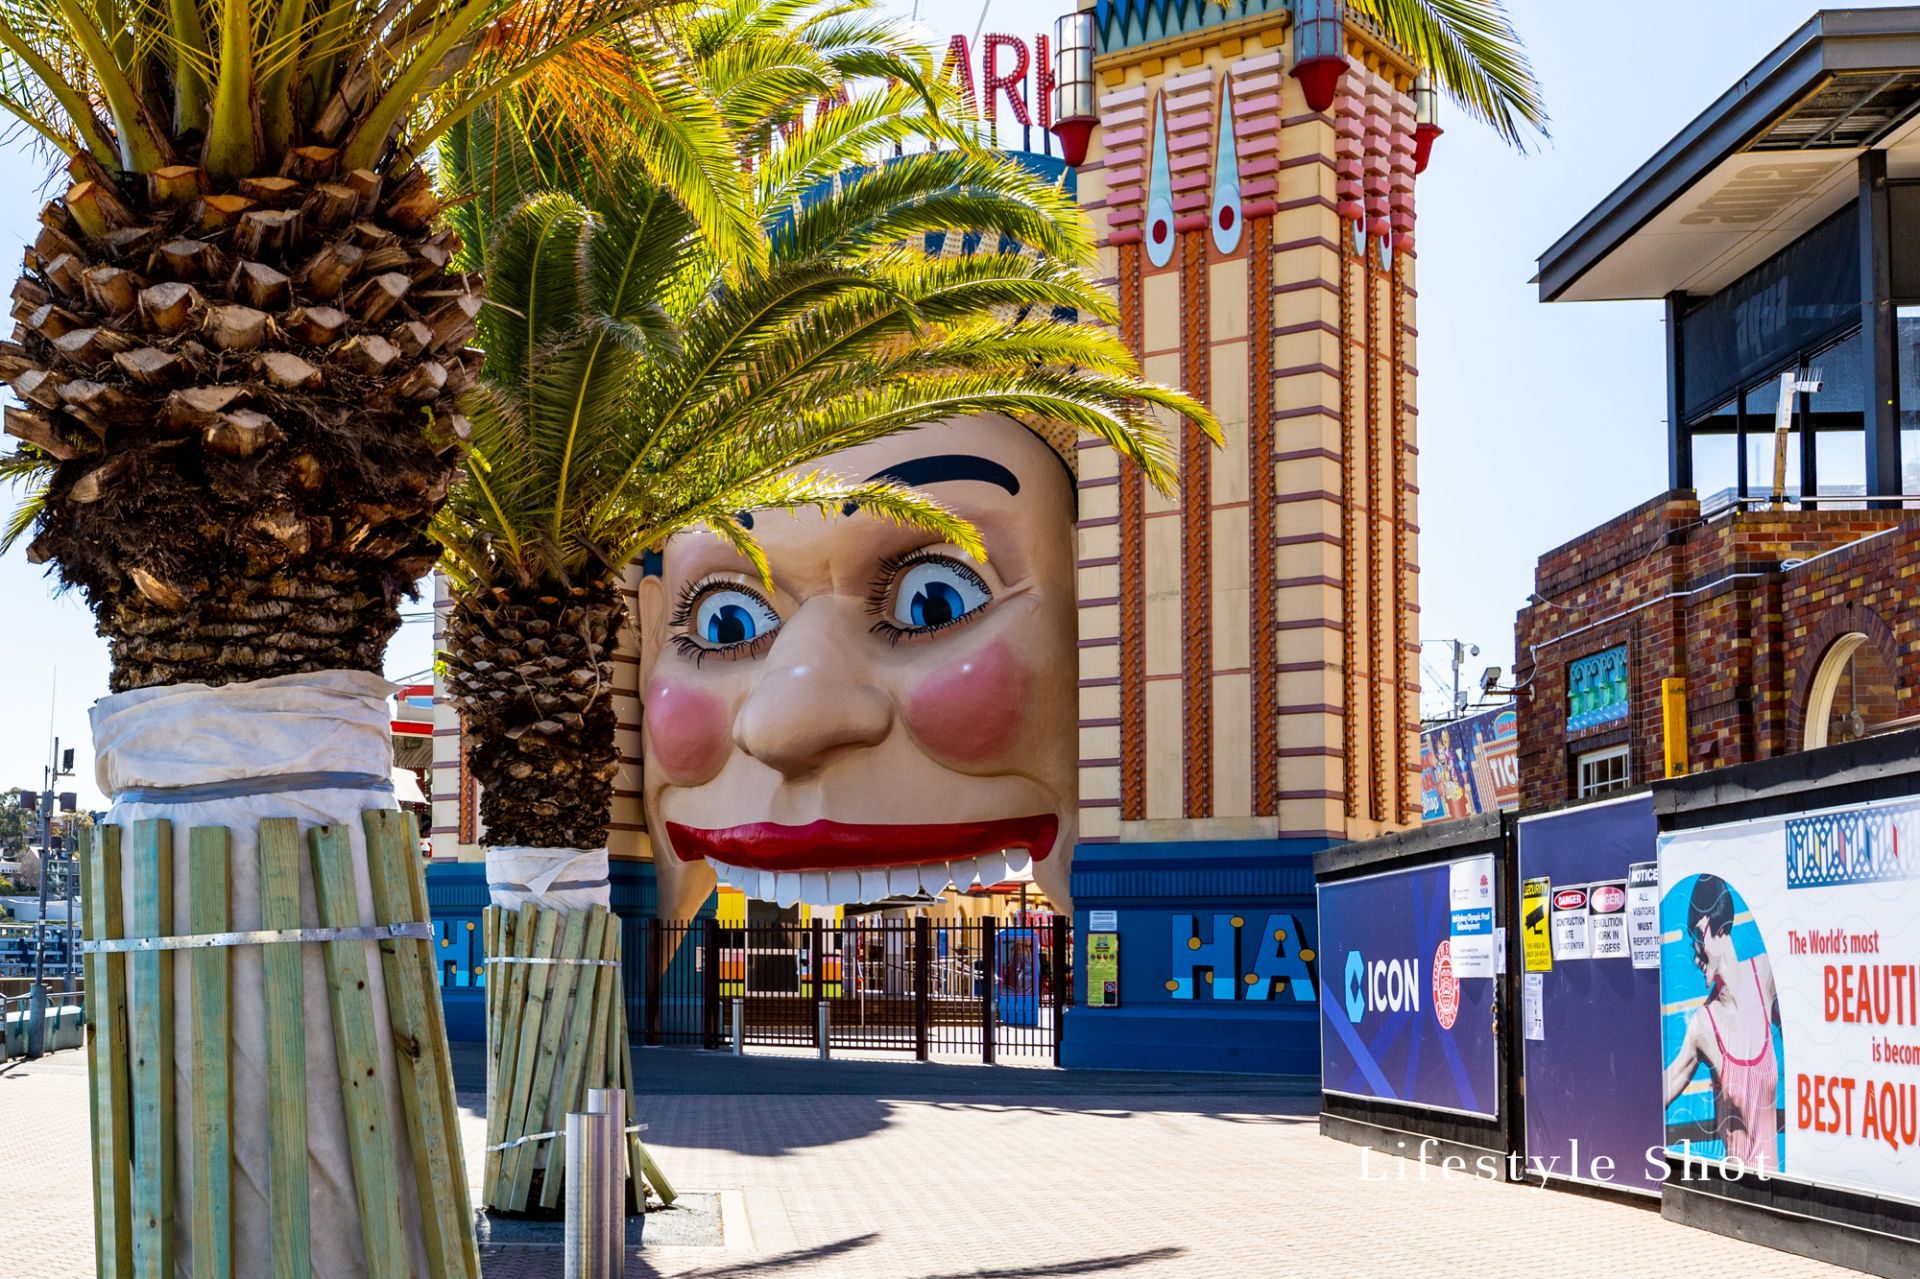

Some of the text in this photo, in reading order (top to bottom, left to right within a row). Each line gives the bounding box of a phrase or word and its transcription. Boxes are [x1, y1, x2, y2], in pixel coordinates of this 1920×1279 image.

[1631, 868, 1658, 882] NOTICE
[1558, 894, 1582, 906] DANGER
[1639, 893, 1648, 901] ALL
[1633, 906, 1655, 917] VISITORS
[1637, 922, 1653, 931] MUST
[1597, 930, 1619, 941] ORK IN
[1633, 936, 1652, 946] REPORT
[1788, 929, 1879, 955] The World's most
[1171, 914, 1317, 1001] HA
[1634, 951, 1660, 960] SITE OFFIC
[1367, 958, 1420, 1012] ICON
[1824, 964, 1920, 1026] BEAUTI
[1872, 1036, 1920, 1065] is becom
[1797, 1073, 1920, 1152] BEST AQU
